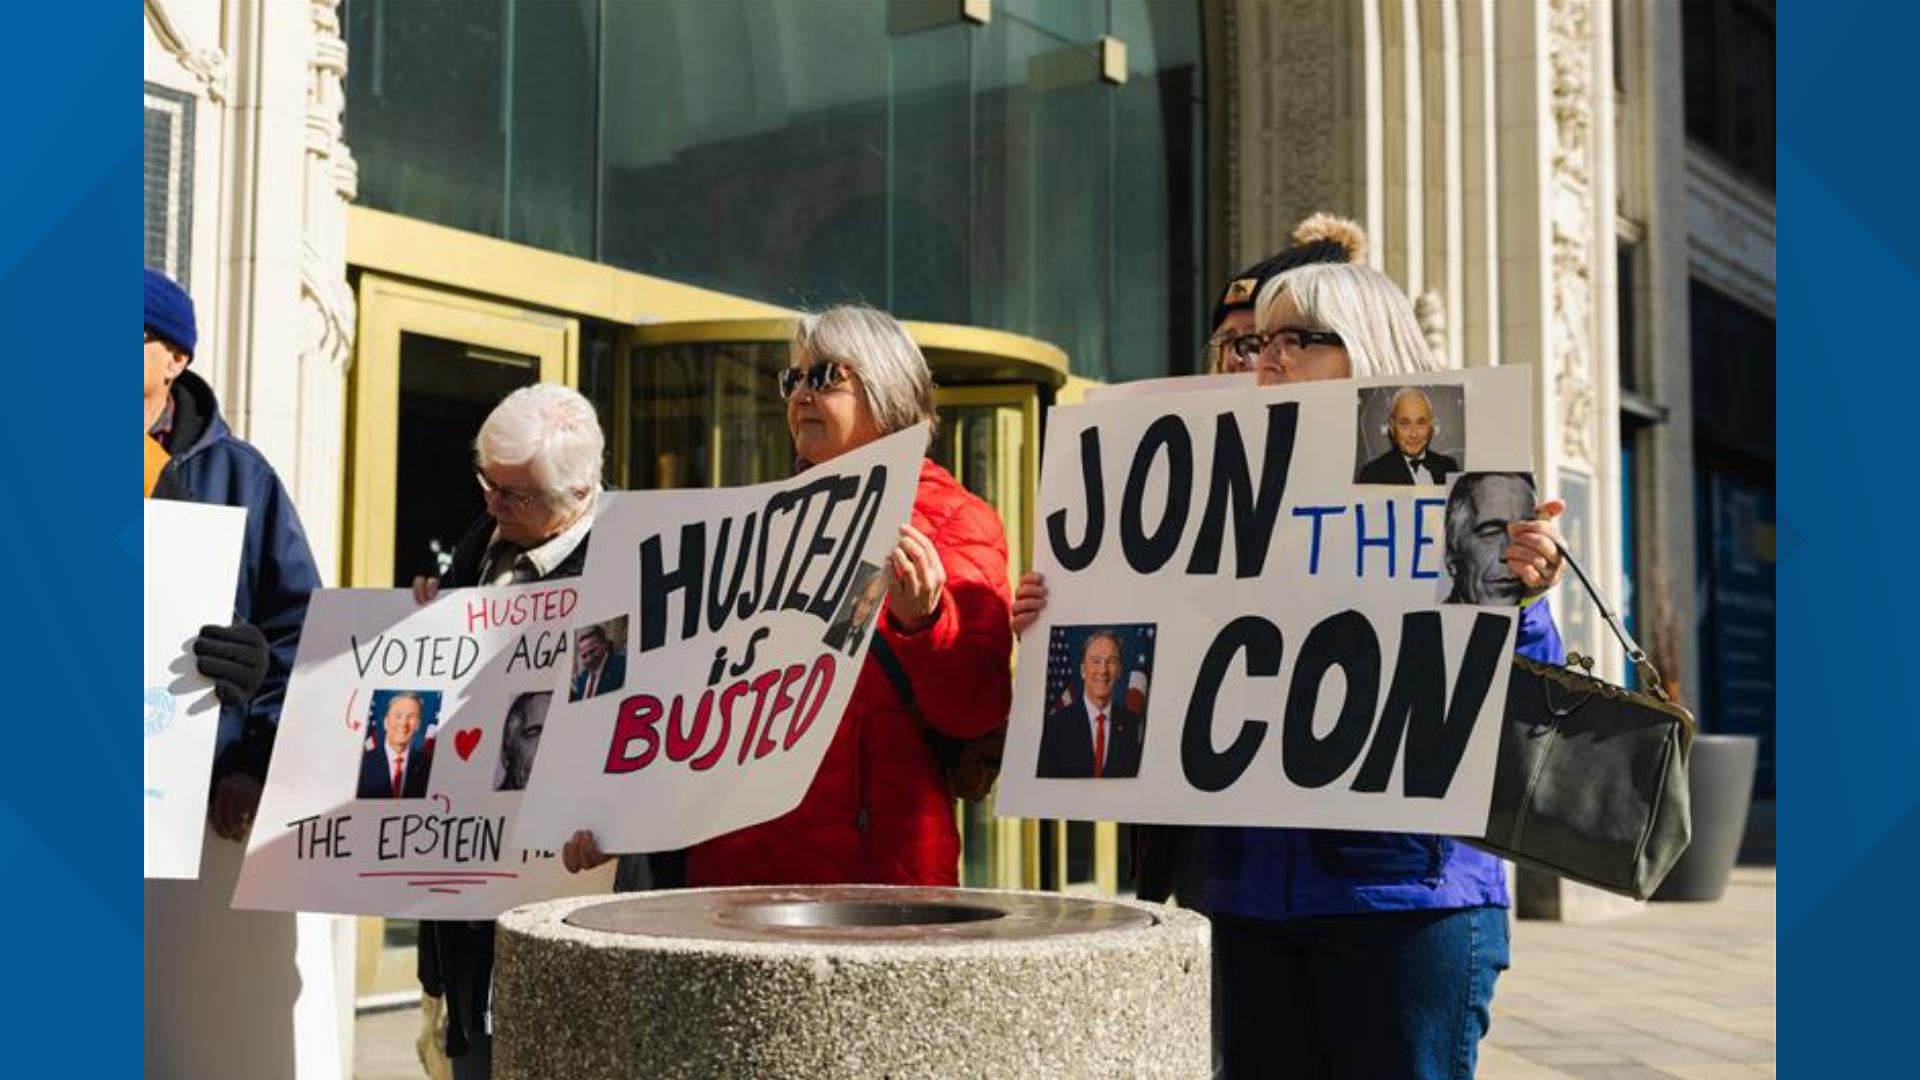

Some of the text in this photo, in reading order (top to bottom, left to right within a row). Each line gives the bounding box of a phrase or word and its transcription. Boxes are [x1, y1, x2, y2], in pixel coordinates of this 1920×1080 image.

[1046, 401, 1300, 579] JON
[1292, 499, 1446, 581] THE
[639, 465, 888, 654] HUSTED
[351, 630, 568, 680] VOTED AGA
[467, 588, 578, 634] HUSTED
[603, 653, 837, 774] BUSTED
[1180, 608, 1511, 799] CON
[286, 815, 352, 861] THE
